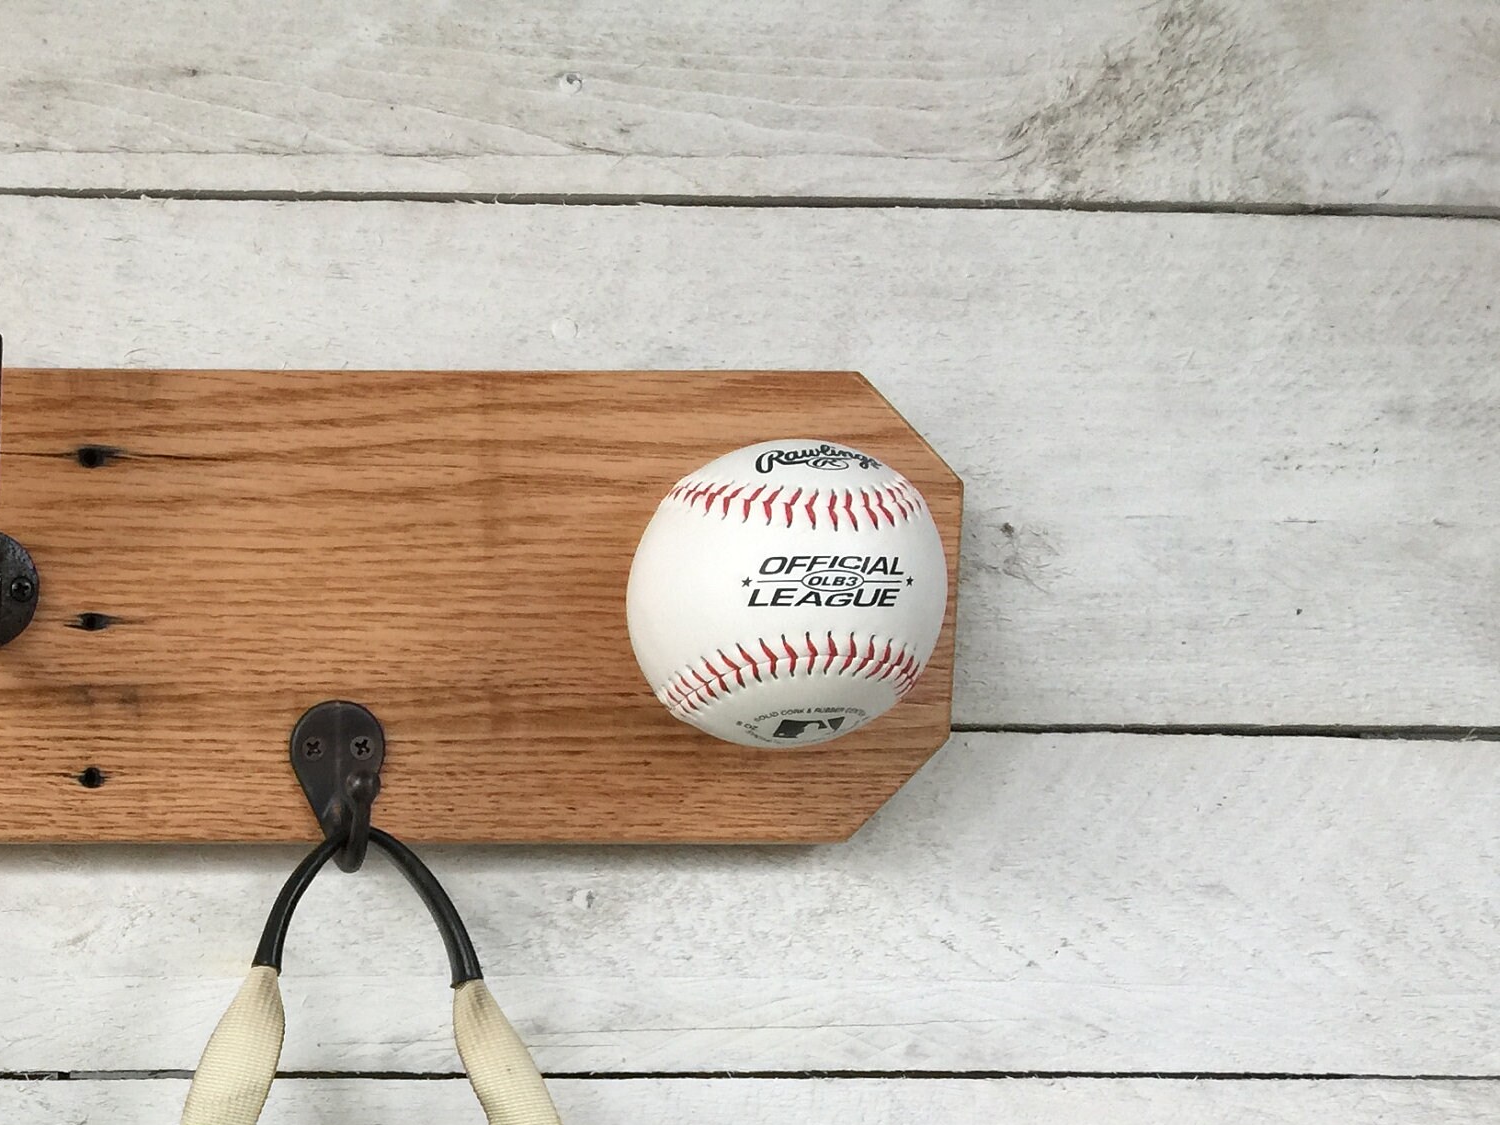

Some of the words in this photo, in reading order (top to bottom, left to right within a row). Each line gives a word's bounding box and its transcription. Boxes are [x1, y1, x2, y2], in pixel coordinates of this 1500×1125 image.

[755, 444, 883, 473] Rawlings
[759, 555, 904, 575] OFFICIAL
[807, 576, 858, 586] OLB3
[748, 588, 901, 607] LEAGUE
[753, 711, 779, 722] SOLID
[780, 708, 805, 716] CORK
